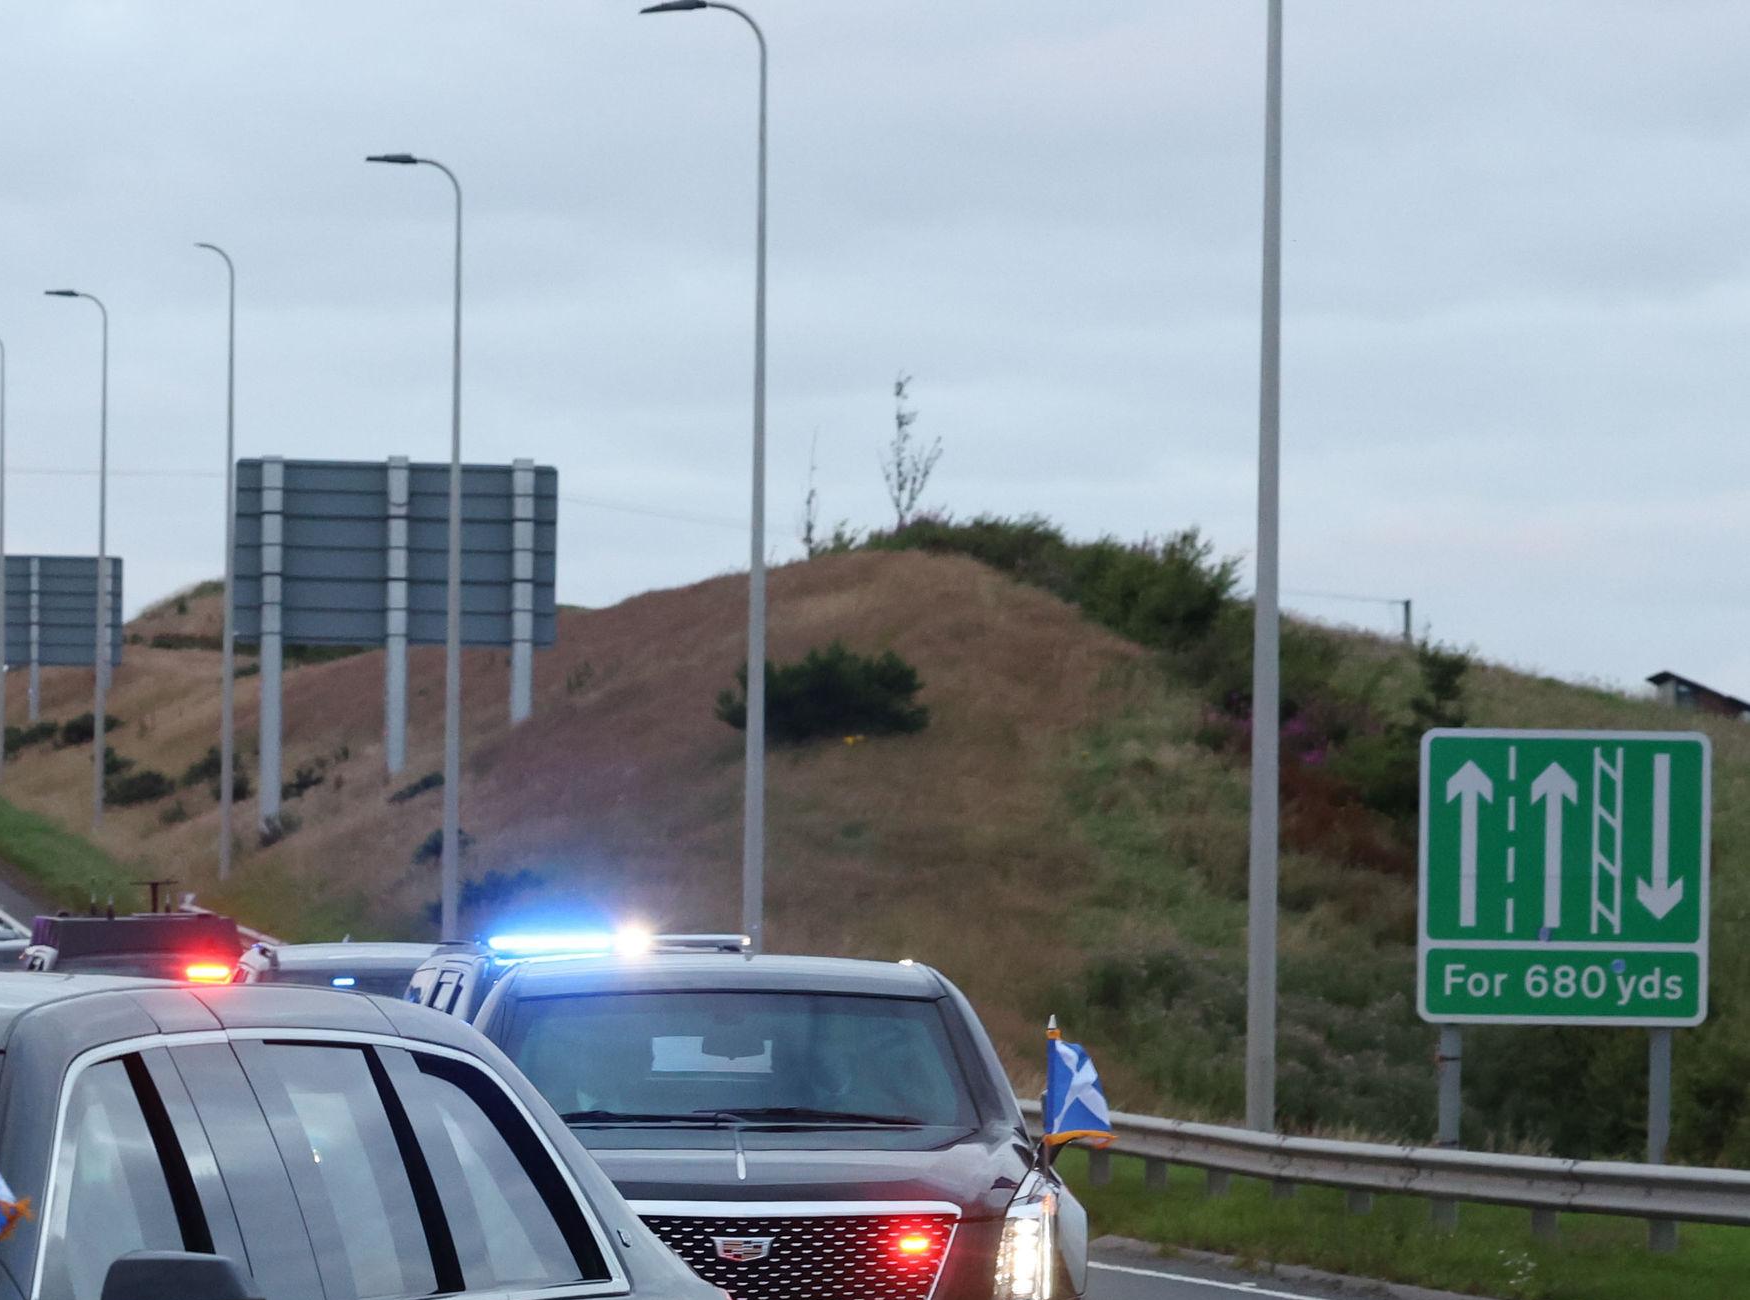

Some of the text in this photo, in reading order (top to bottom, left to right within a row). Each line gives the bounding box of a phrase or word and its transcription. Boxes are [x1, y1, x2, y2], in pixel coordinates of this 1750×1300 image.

[1443, 963, 1683, 1006] For 680 yds
